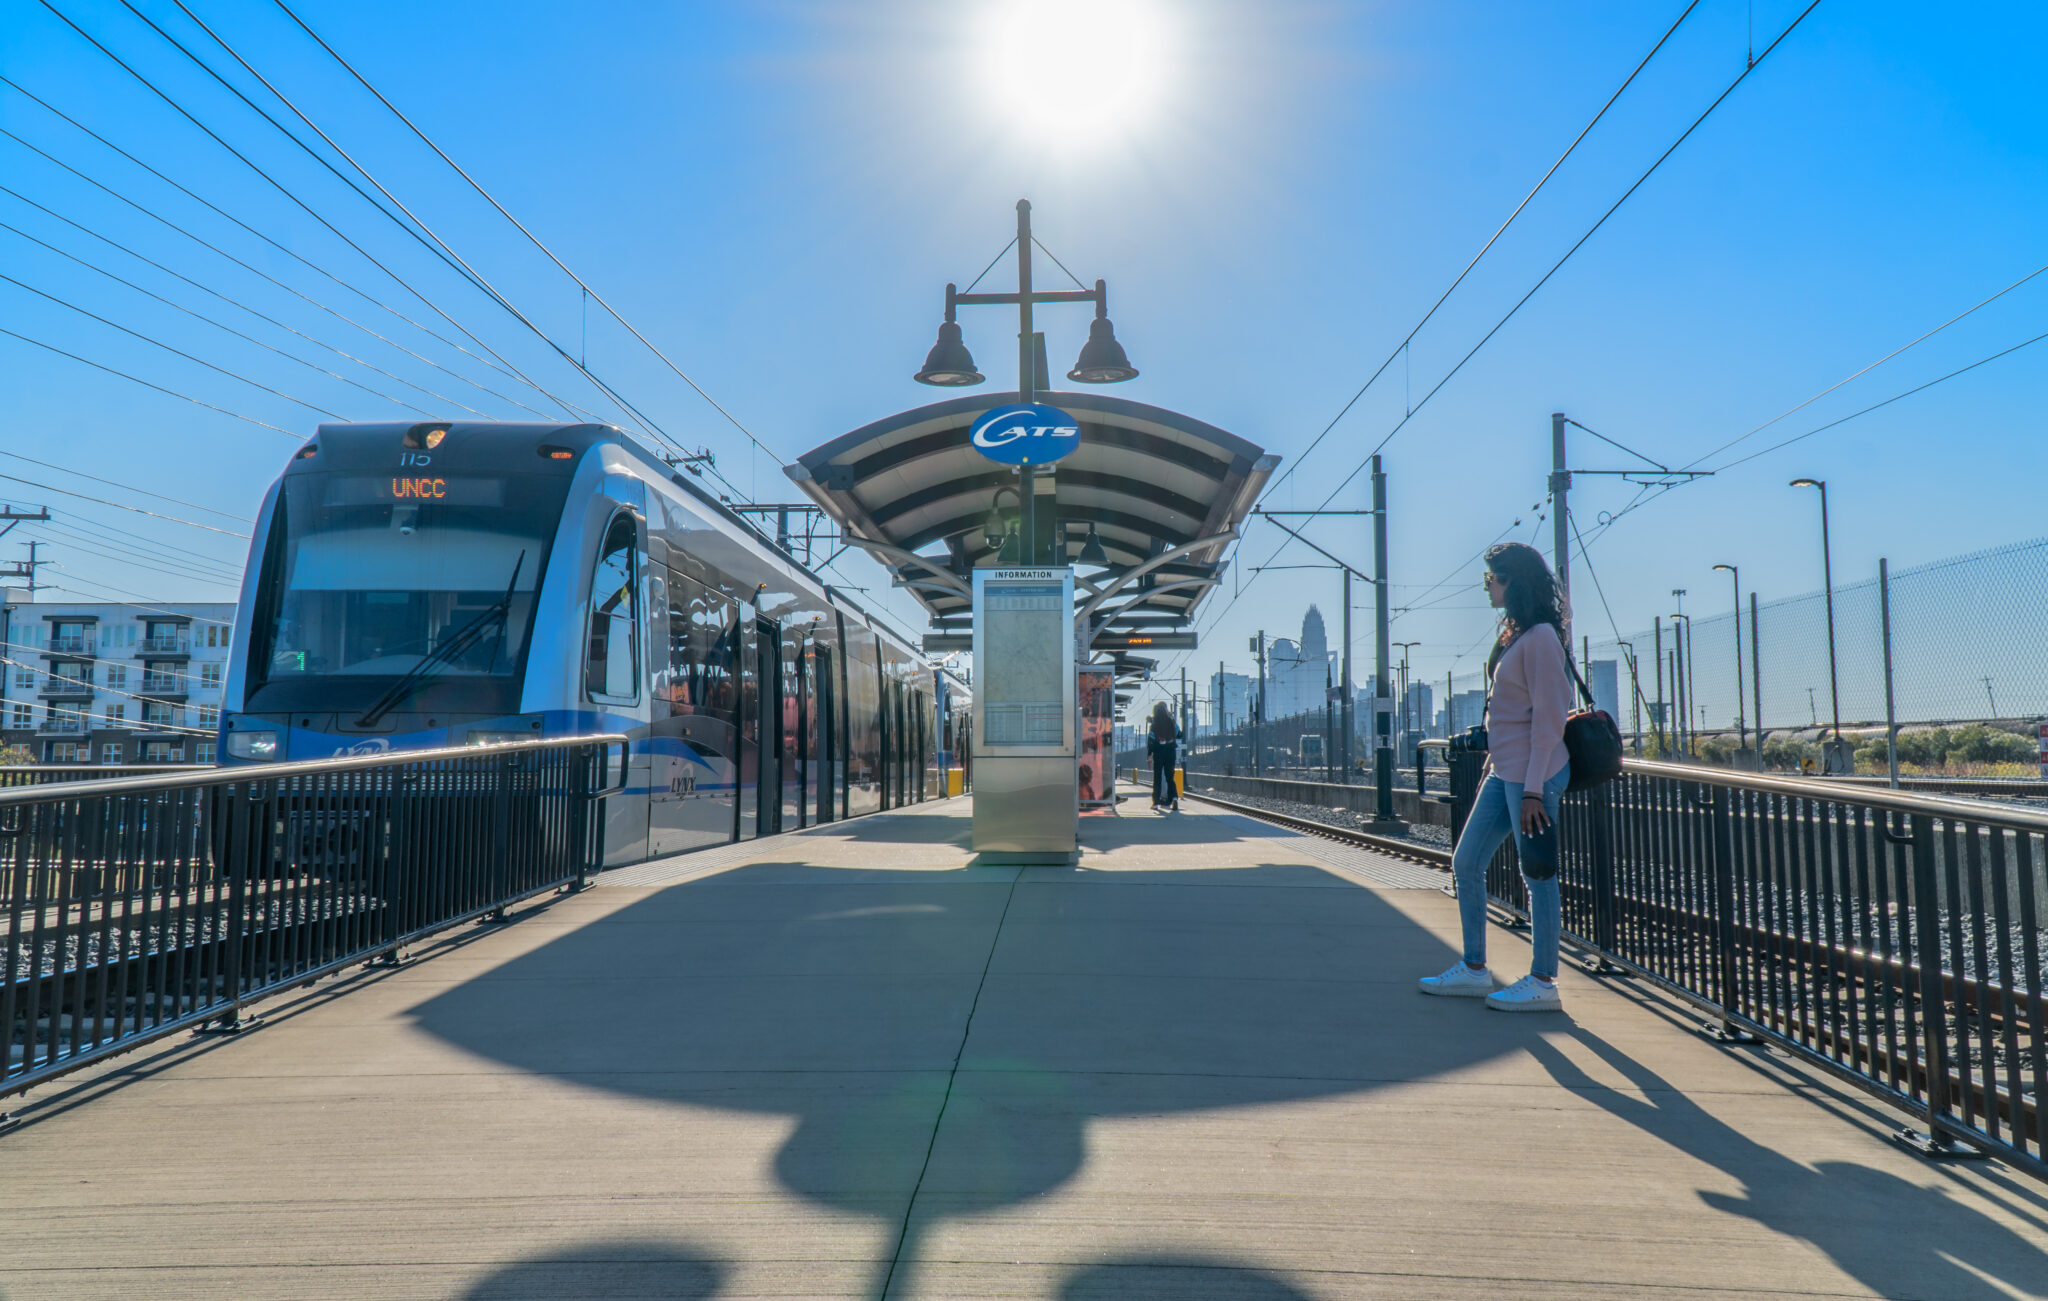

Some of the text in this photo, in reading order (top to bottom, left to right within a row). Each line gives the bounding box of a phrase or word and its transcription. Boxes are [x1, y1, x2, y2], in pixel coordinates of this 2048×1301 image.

[973, 410, 1078, 447] CATS
[393, 478, 446, 498] UNCC
[995, 571, 1052, 579] INFORMATION
[671, 776, 697, 793] LYNX
